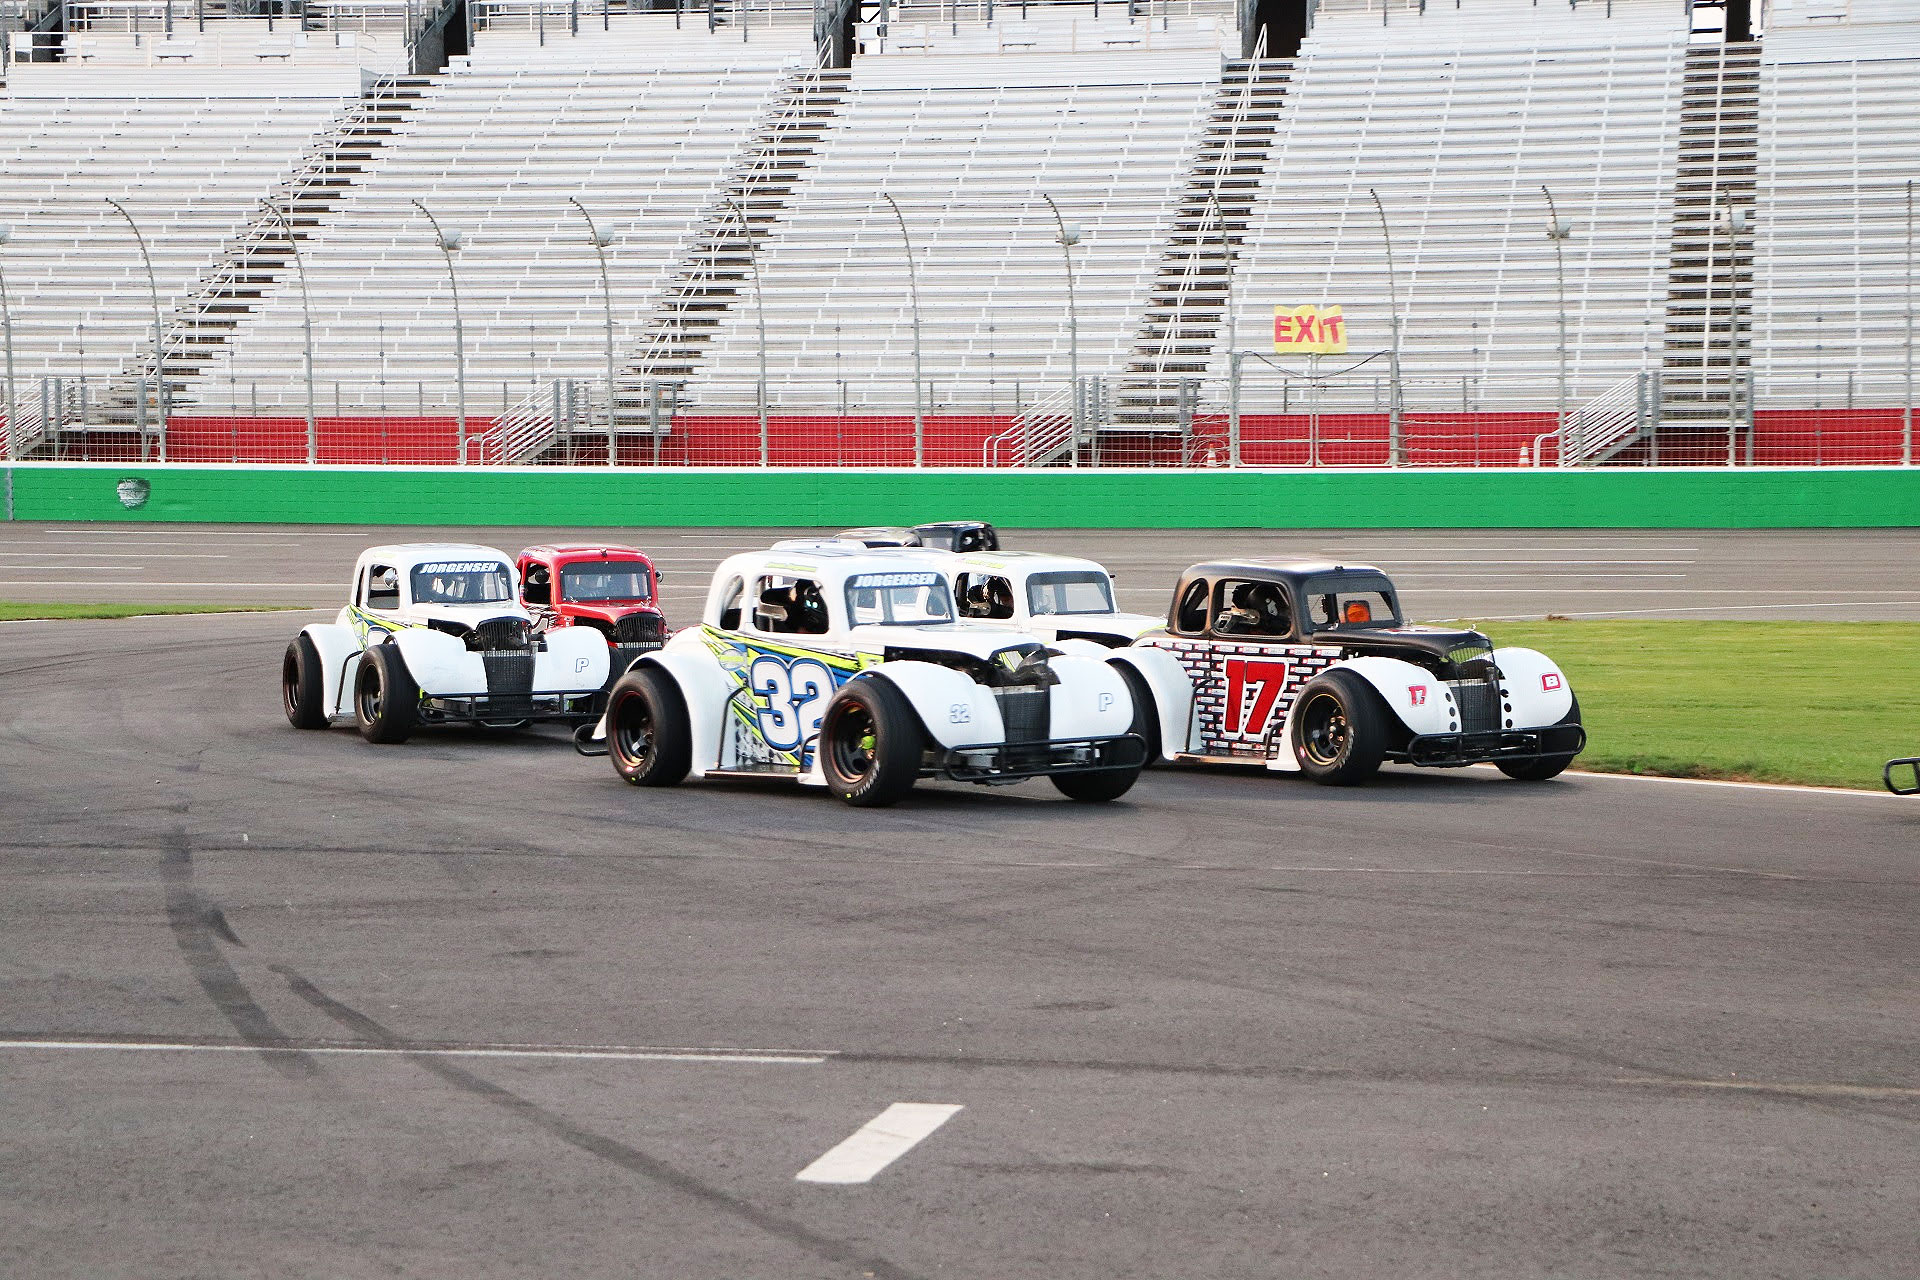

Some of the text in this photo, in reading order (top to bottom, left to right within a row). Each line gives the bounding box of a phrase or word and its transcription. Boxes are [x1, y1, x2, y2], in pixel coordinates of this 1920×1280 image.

[1275, 315, 1344, 344] EXIT
[420, 562, 499, 574] JORGENSEN
[853, 573, 937, 587] JORGENSEN
[575, 657, 590, 673] P
[751, 655, 838, 752] 32
[1099, 692, 1113, 712] P
[1225, 659, 1286, 734] 17
[1407, 684, 1427, 706] 17
[950, 703, 971, 723] 32
